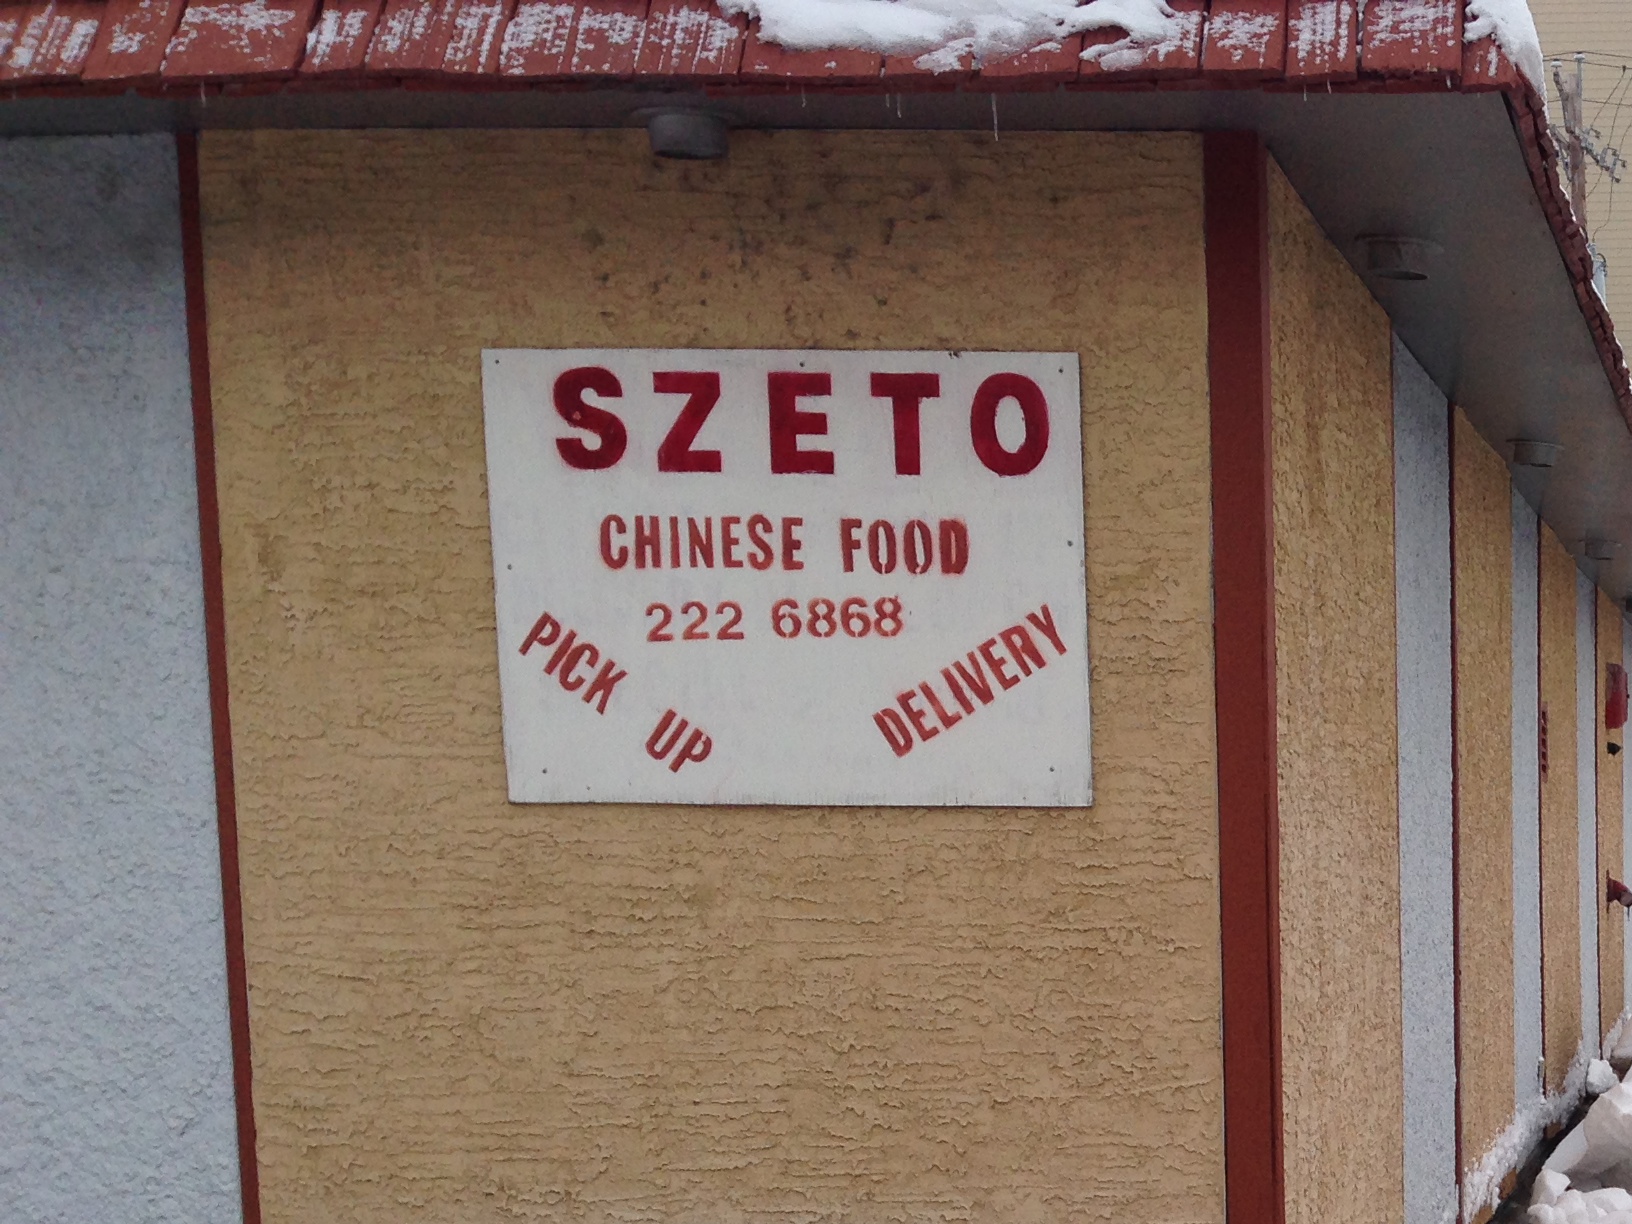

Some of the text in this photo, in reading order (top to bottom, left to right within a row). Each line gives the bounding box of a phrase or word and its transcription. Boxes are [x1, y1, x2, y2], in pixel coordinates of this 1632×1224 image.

[552, 366, 1051, 477] SZETO
[599, 513, 970, 576] CHINESE FOOD
[645, 595, 905, 642] 222 6868
[518, 610, 714, 774] PICK UP
[871, 604, 1069, 759] DELIVERY
